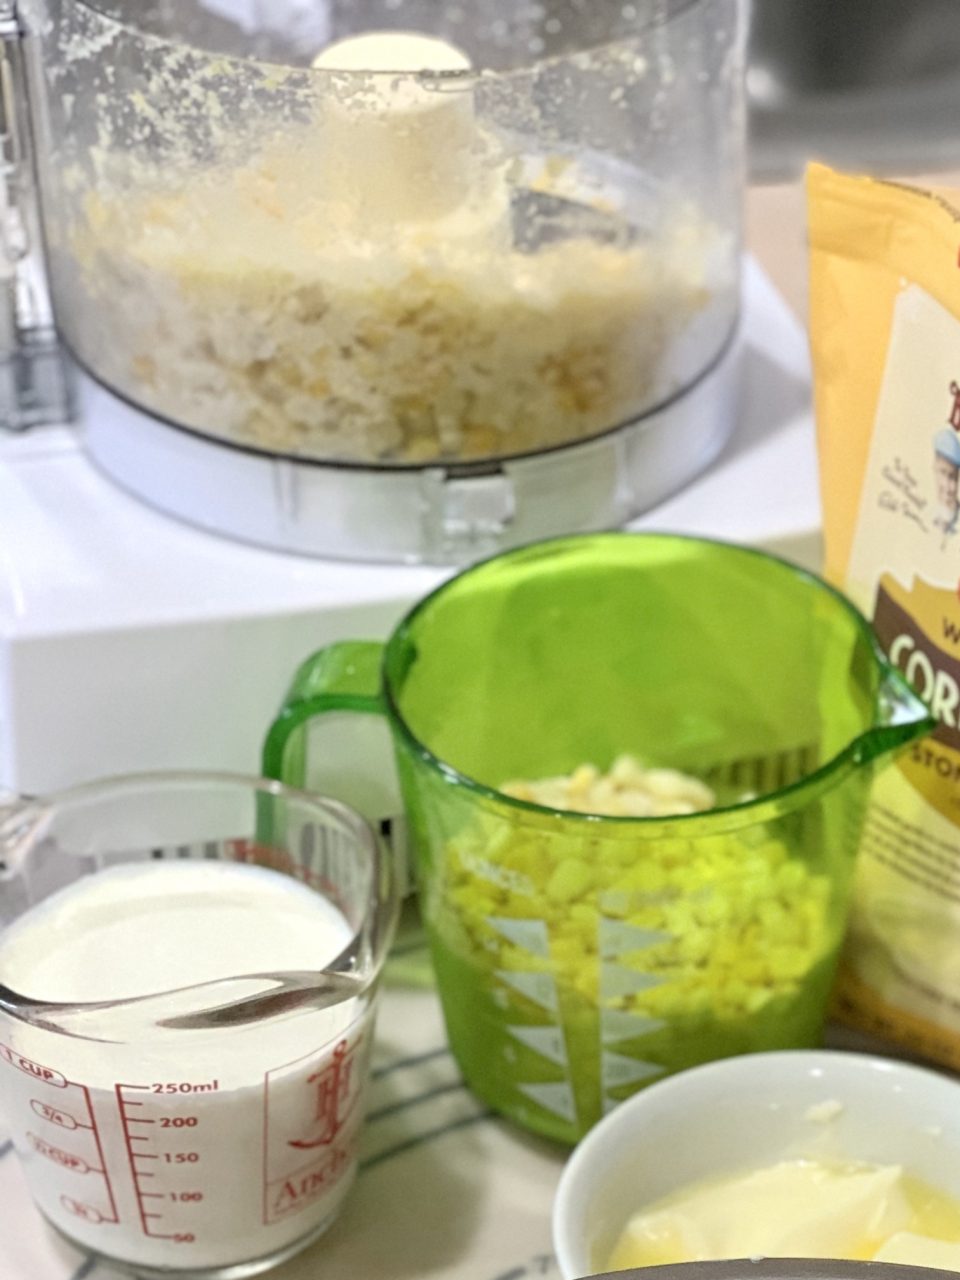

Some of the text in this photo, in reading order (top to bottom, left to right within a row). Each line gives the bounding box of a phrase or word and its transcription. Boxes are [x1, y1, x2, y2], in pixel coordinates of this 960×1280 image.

[19, 1058, 54, 1081] CUP
[151, 1079, 219, 1097] 250ml
[159, 1115, 198, 1129] 200
[164, 1151, 199, 1165] 150
[169, 1189, 204, 1204] 100
